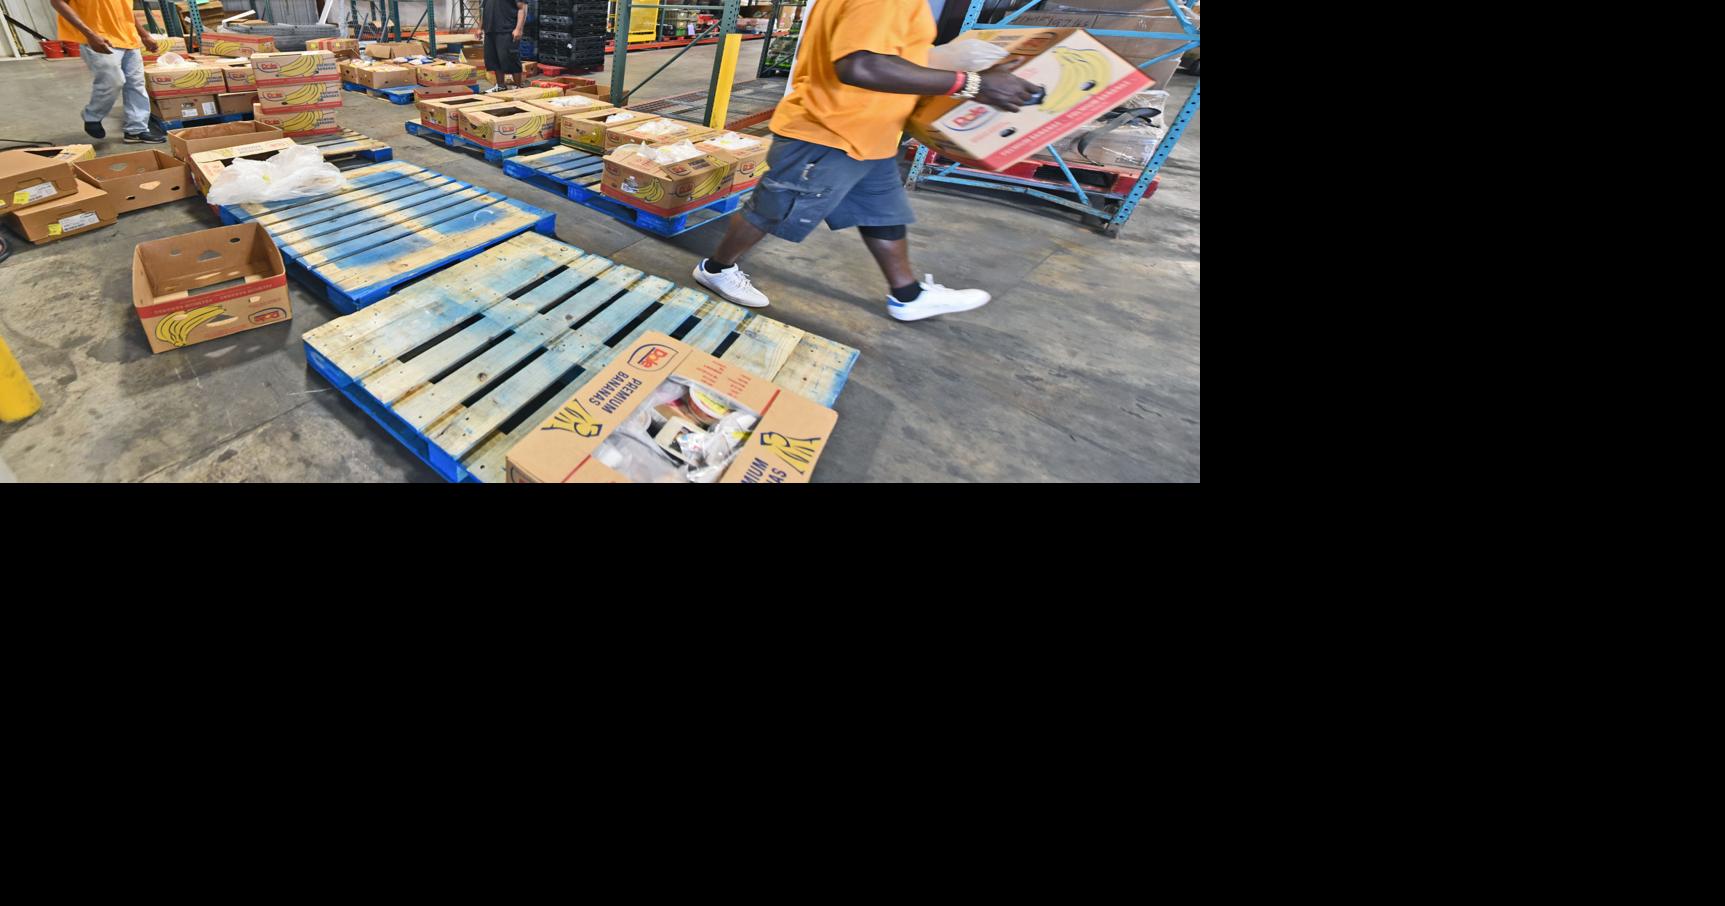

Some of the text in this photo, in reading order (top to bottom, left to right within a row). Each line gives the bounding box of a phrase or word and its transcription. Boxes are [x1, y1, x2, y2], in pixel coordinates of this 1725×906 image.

[640, 348, 669, 369] Dole
[588, 370, 630, 407] BANANAS
[601, 377, 643, 414] PREMIUM
[741, 457, 769, 483] MIUM
